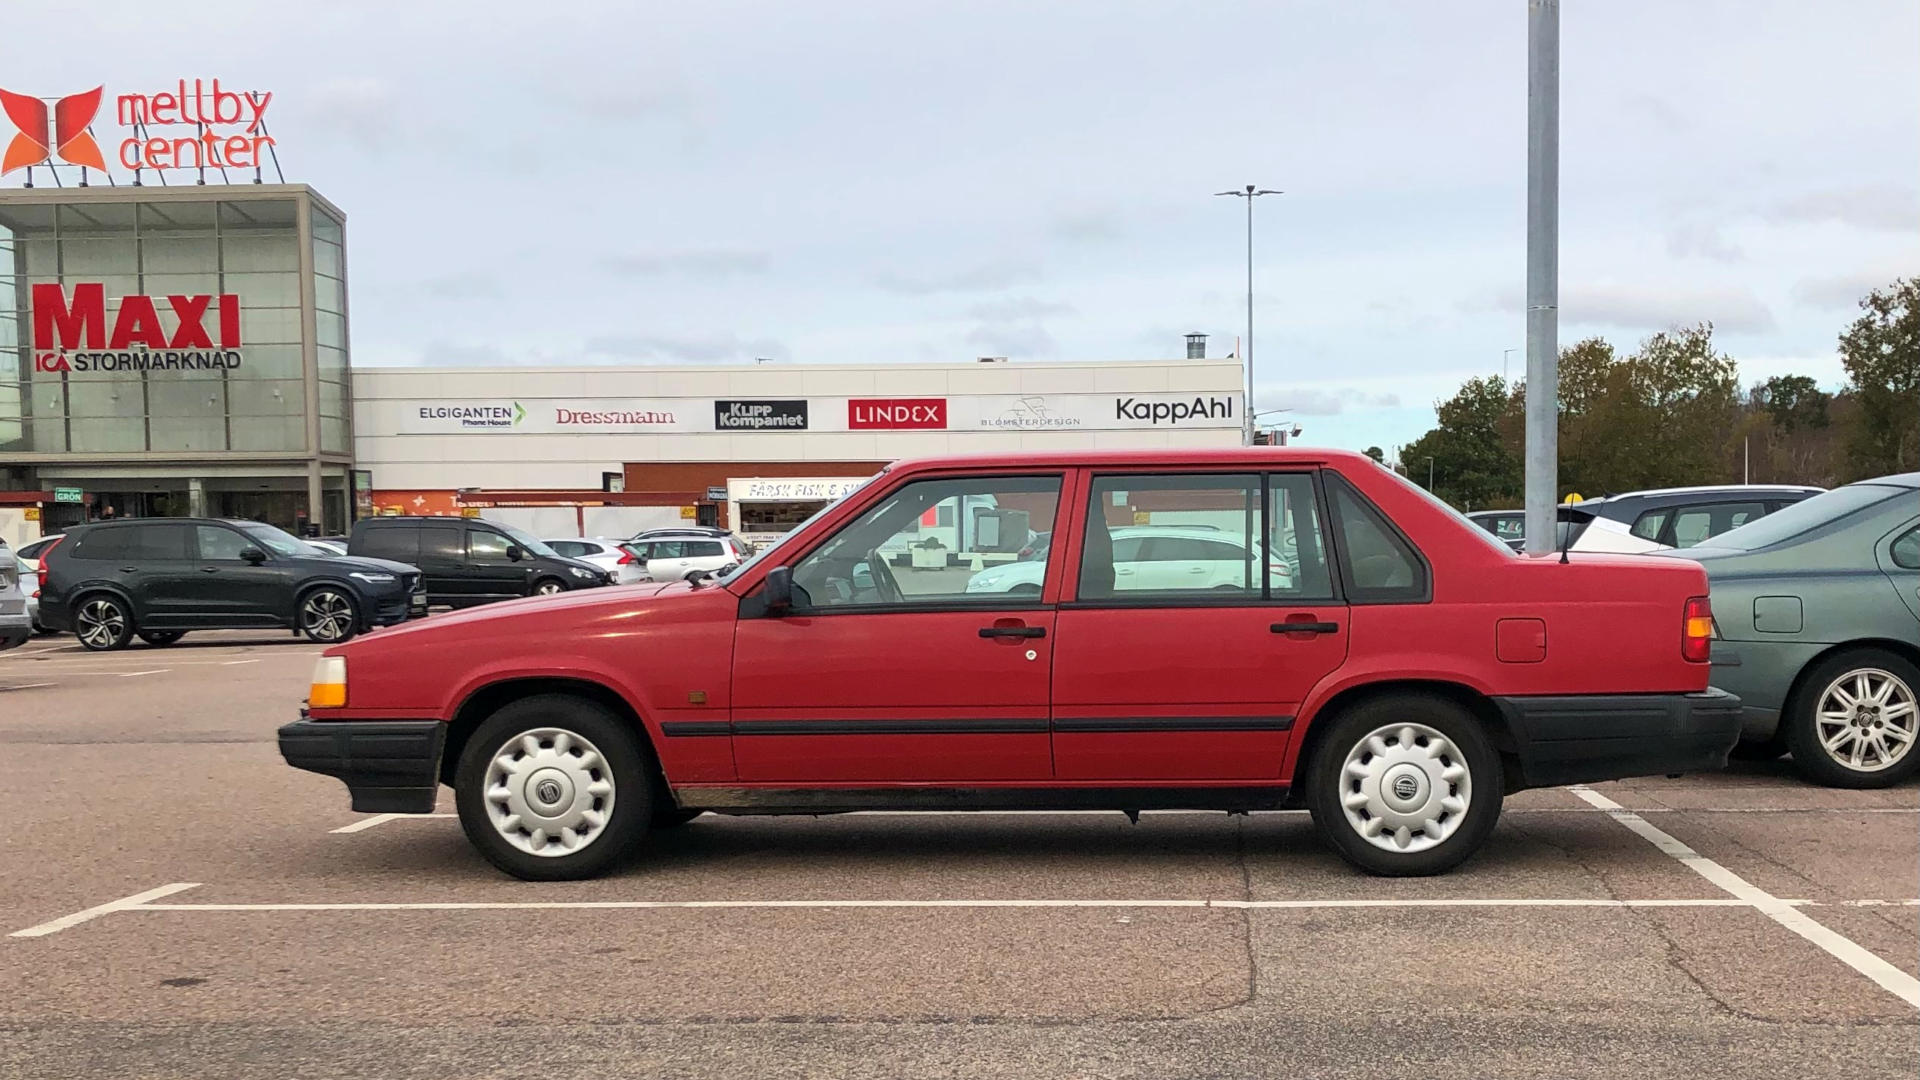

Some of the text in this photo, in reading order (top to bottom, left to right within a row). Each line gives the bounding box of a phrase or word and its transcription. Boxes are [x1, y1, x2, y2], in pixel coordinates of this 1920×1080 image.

[117, 78, 273, 133] mellby
[120, 129, 276, 170] center
[32, 283, 241, 350] MAXI
[36, 352, 241, 372] ICA STORMARKNAD
[420, 407, 512, 419] ELGIGANTEN
[556, 408, 676, 424] Dressmann
[730, 403, 773, 416] KLIPP
[856, 406, 939, 422] LINDEX
[1116, 397, 1232, 424] KappAhl
[720, 412, 804, 429] Kompaniet
[980, 418, 1081, 426] BLOMSTERDESIGN
